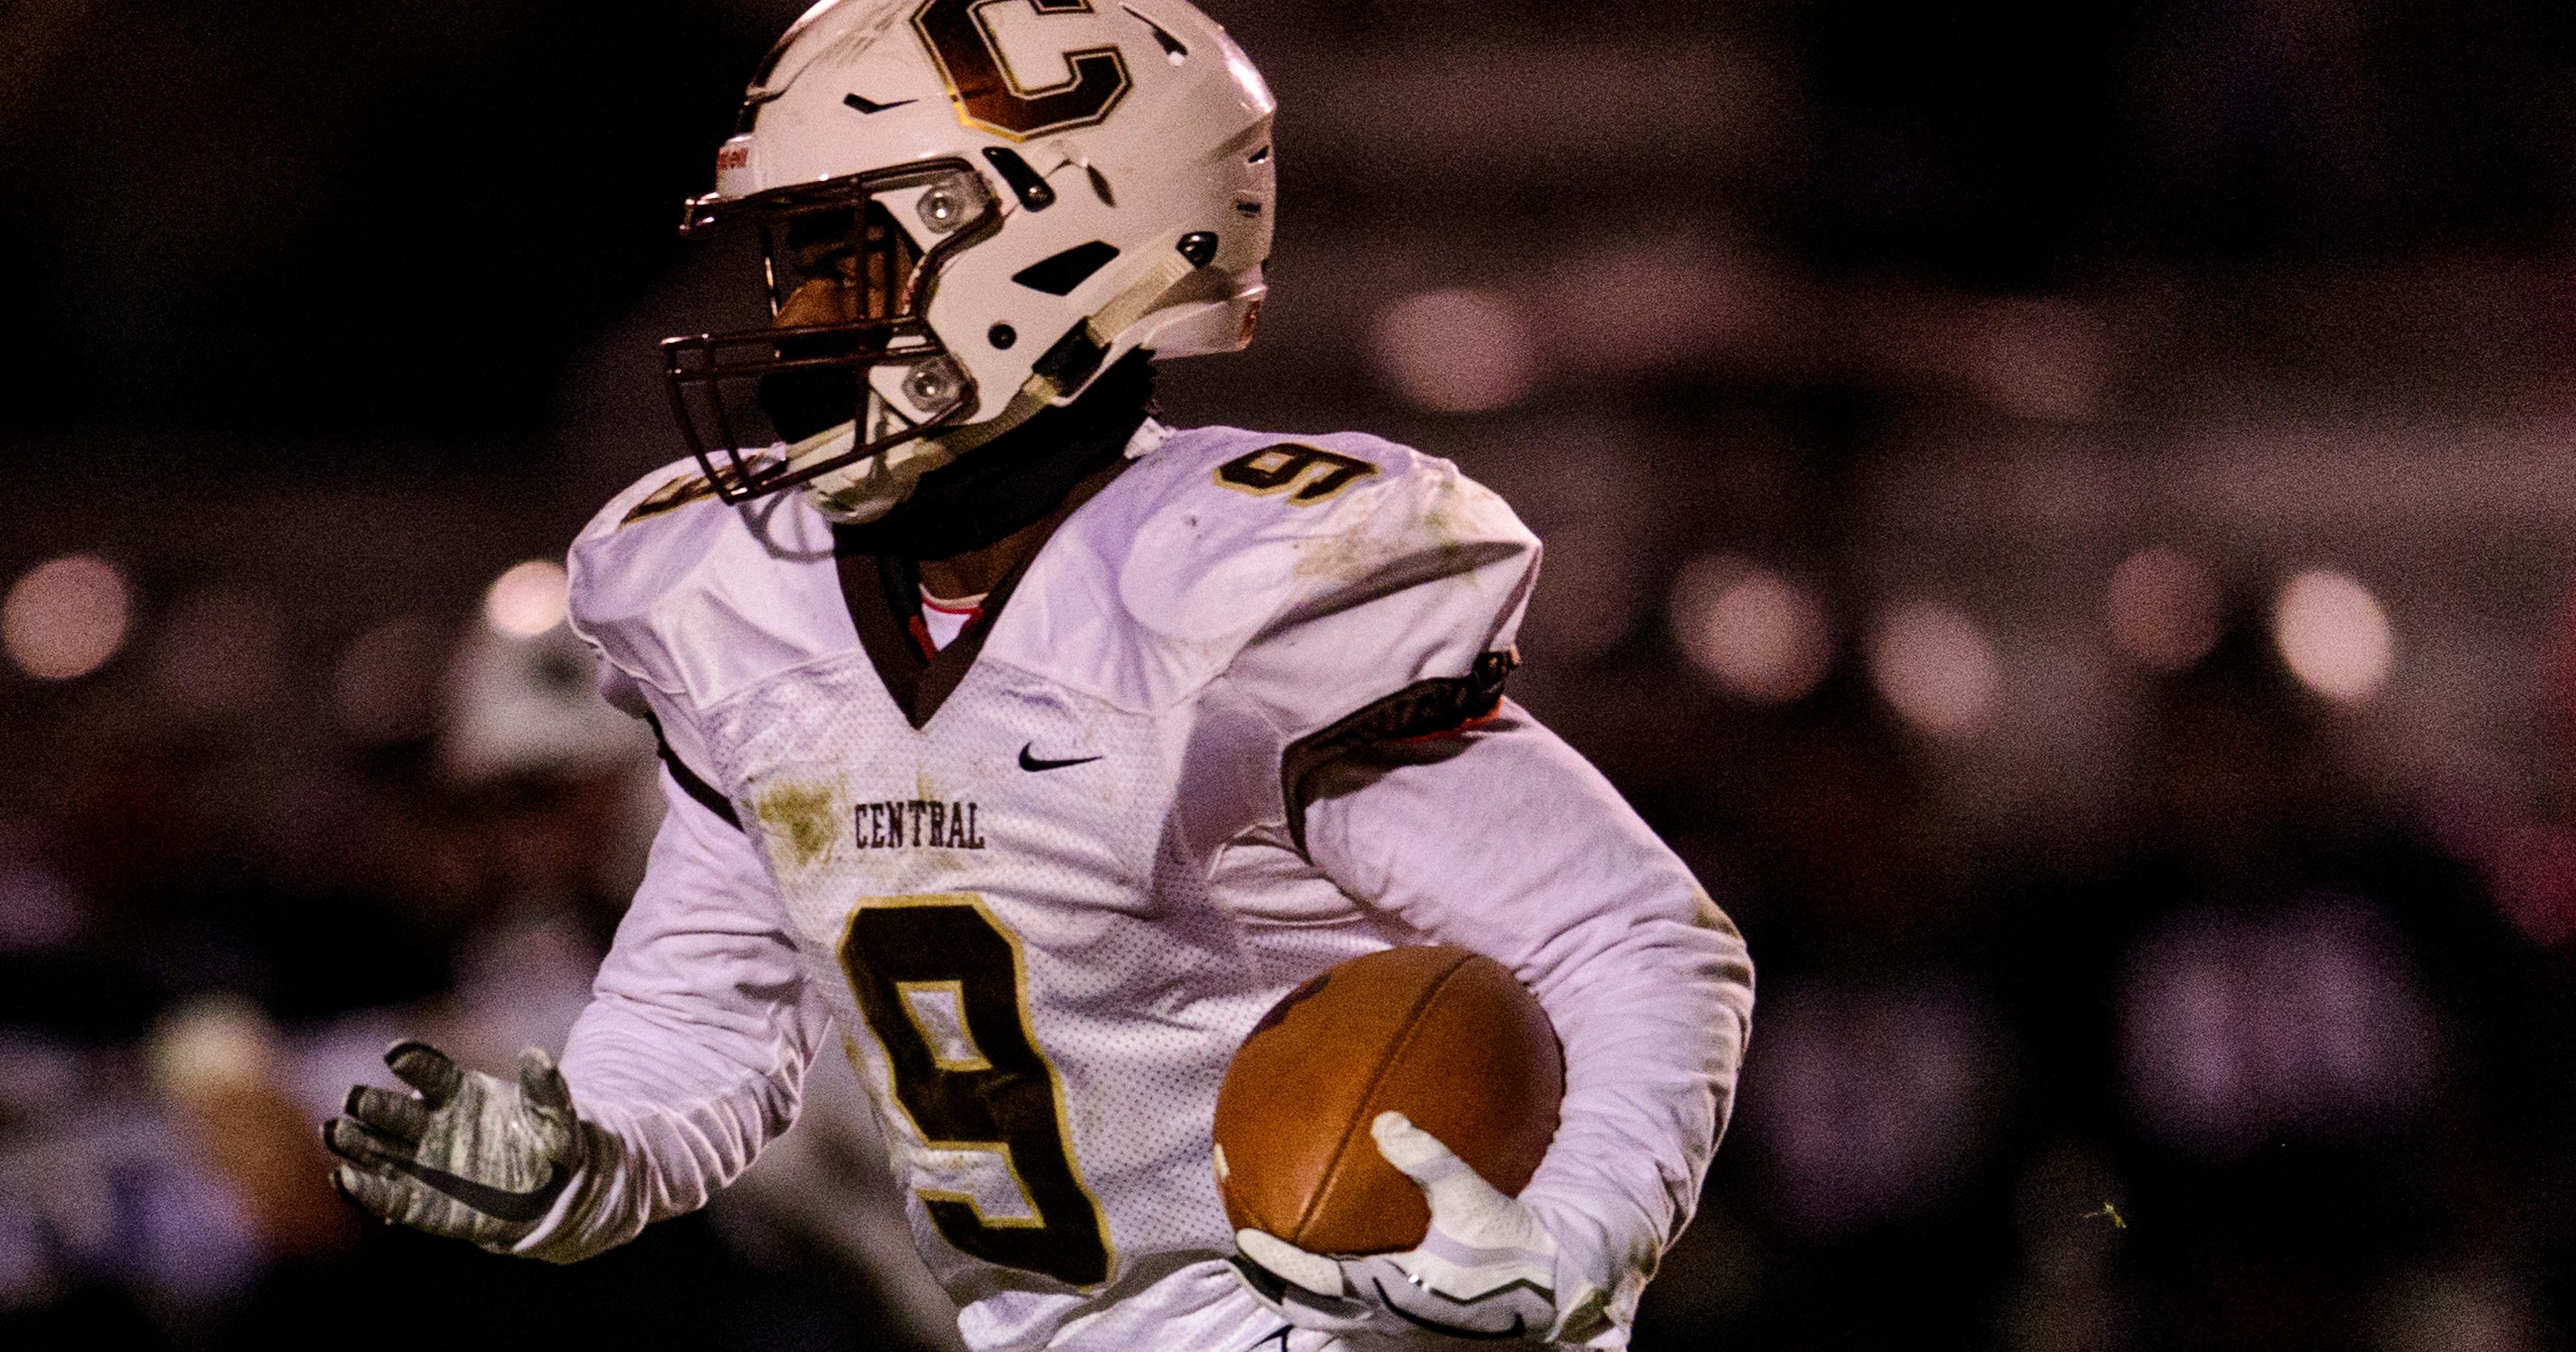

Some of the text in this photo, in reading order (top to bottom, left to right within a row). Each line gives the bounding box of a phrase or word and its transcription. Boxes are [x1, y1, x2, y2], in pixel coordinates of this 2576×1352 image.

[910, 0, 1133, 142] C
[1212, 442, 1382, 508] 9
[854, 800, 985, 849] CENTRAL
[837, 894, 1117, 1289] 9
